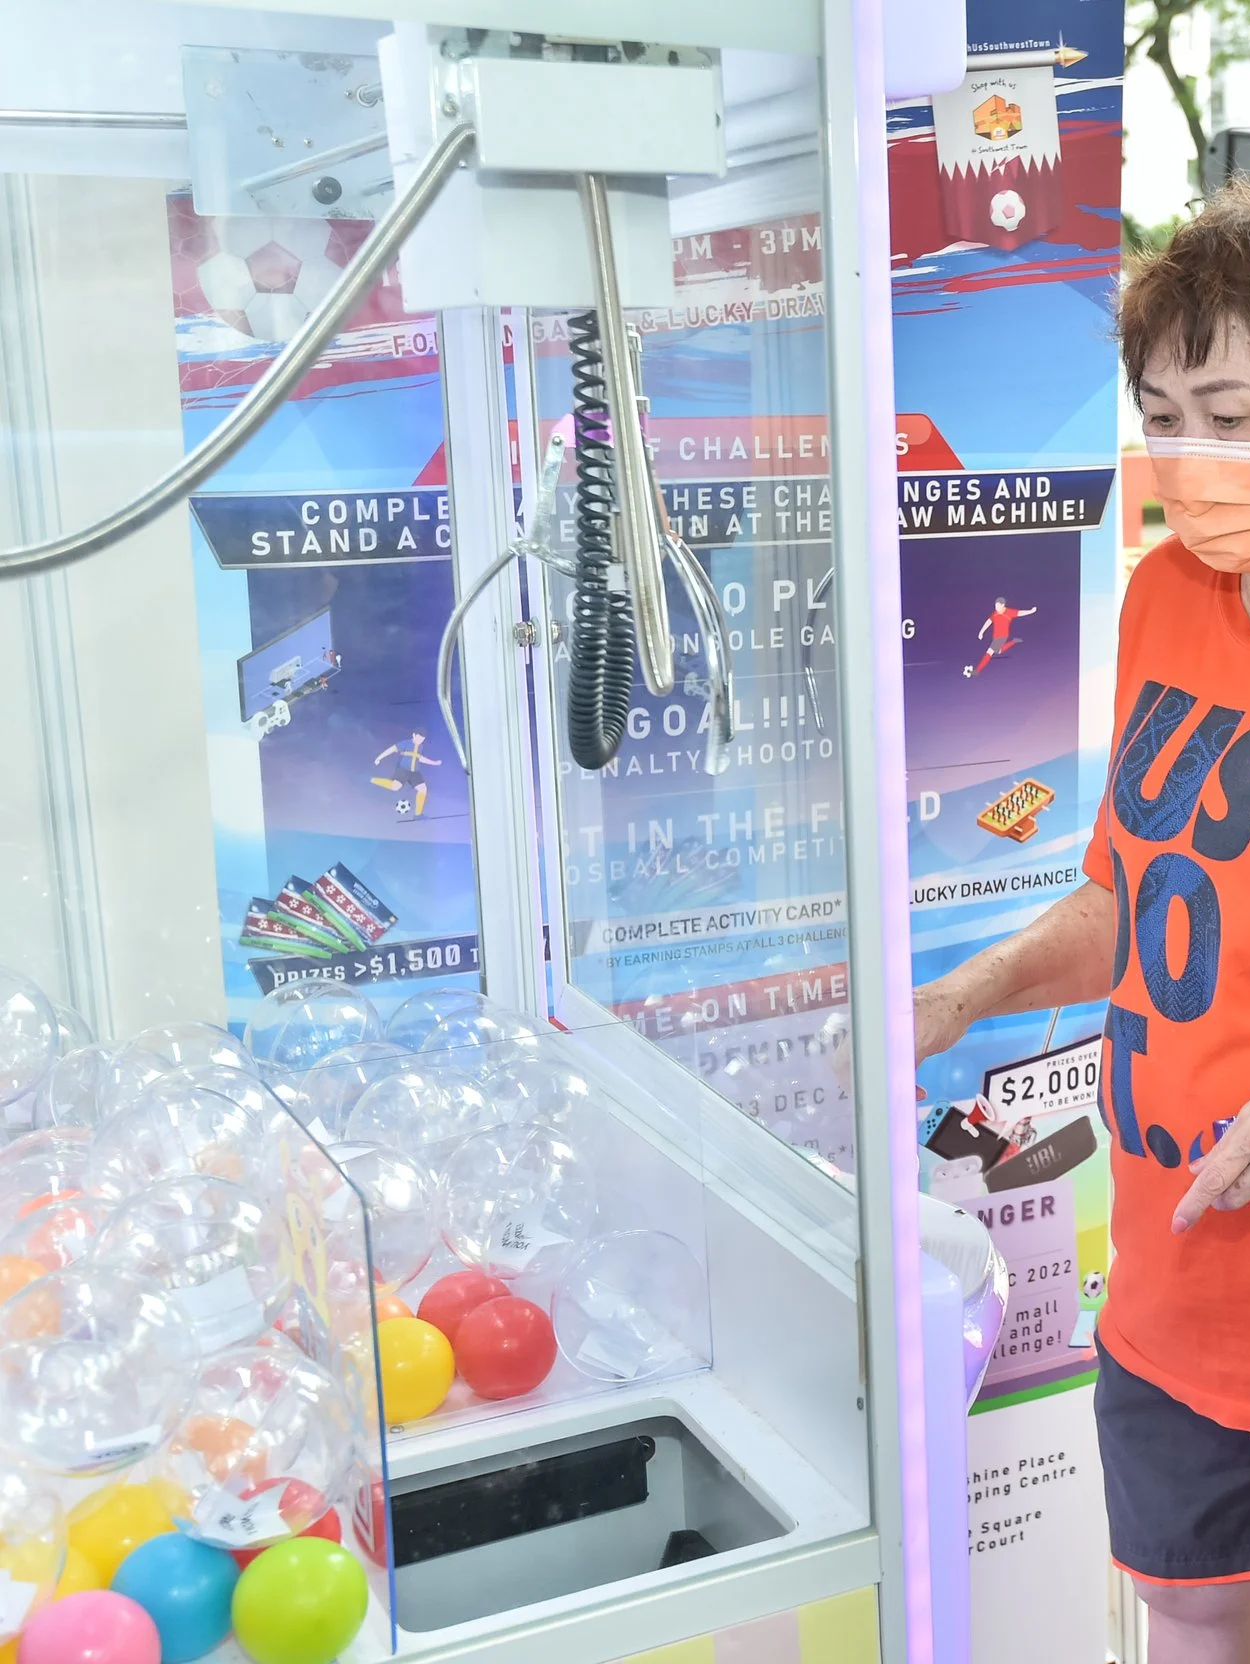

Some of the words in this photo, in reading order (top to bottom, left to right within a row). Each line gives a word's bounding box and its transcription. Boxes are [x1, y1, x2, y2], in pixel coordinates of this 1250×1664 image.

[967, 40, 1050, 52] hUsSouthwestTown
[990, 77, 1007, 88] with
[760, 226, 823, 256] 3PM
[667, 301, 754, 330] LUCKY
[994, 476, 1051, 499] AND
[301, 495, 450, 525] COMPLE
[947, 499, 1085, 526] MACHINE!
[726, 513, 761, 538] AT
[776, 510, 832, 535] THE
[250, 526, 377, 557] STAND
[397, 527, 418, 550] A
[627, 817, 674, 853] IN
[697, 803, 785, 845] THE
[909, 885, 958, 905] UCKY
[961, 878, 1008, 898] DRAW
[1011, 867, 1077, 891] CHANCE!
[602, 916, 702, 944] COMPLETE
[706, 905, 782, 932] ACTIVITY
[606, 956, 621, 969] BY
[624, 949, 682, 967] EARNING
[683, 941, 734, 959] STAMPS
[702, 992, 747, 1023] ON
[763, 973, 847, 1011] TIME
[1046, 1056, 1076, 1069] PRIZES
[1078, 1051, 1098, 1062] OVER
[1001, 1062, 1097, 1106] $2,000
[775, 1086, 825, 1113] DEC
[1043, 1100, 1054, 1109] TO
[1057, 1096, 1069, 1106] BE
[1072, 1091, 1095, 1103] WON!
[1027, 1259, 1072, 1283] 2022
[1016, 1300, 1058, 1323] mall
[1009, 1320, 1043, 1339] and
[1018, 1451, 1066, 1471] Place
[1020, 1465, 1077, 1488] Centre
[981, 1509, 1042, 1535] Square
